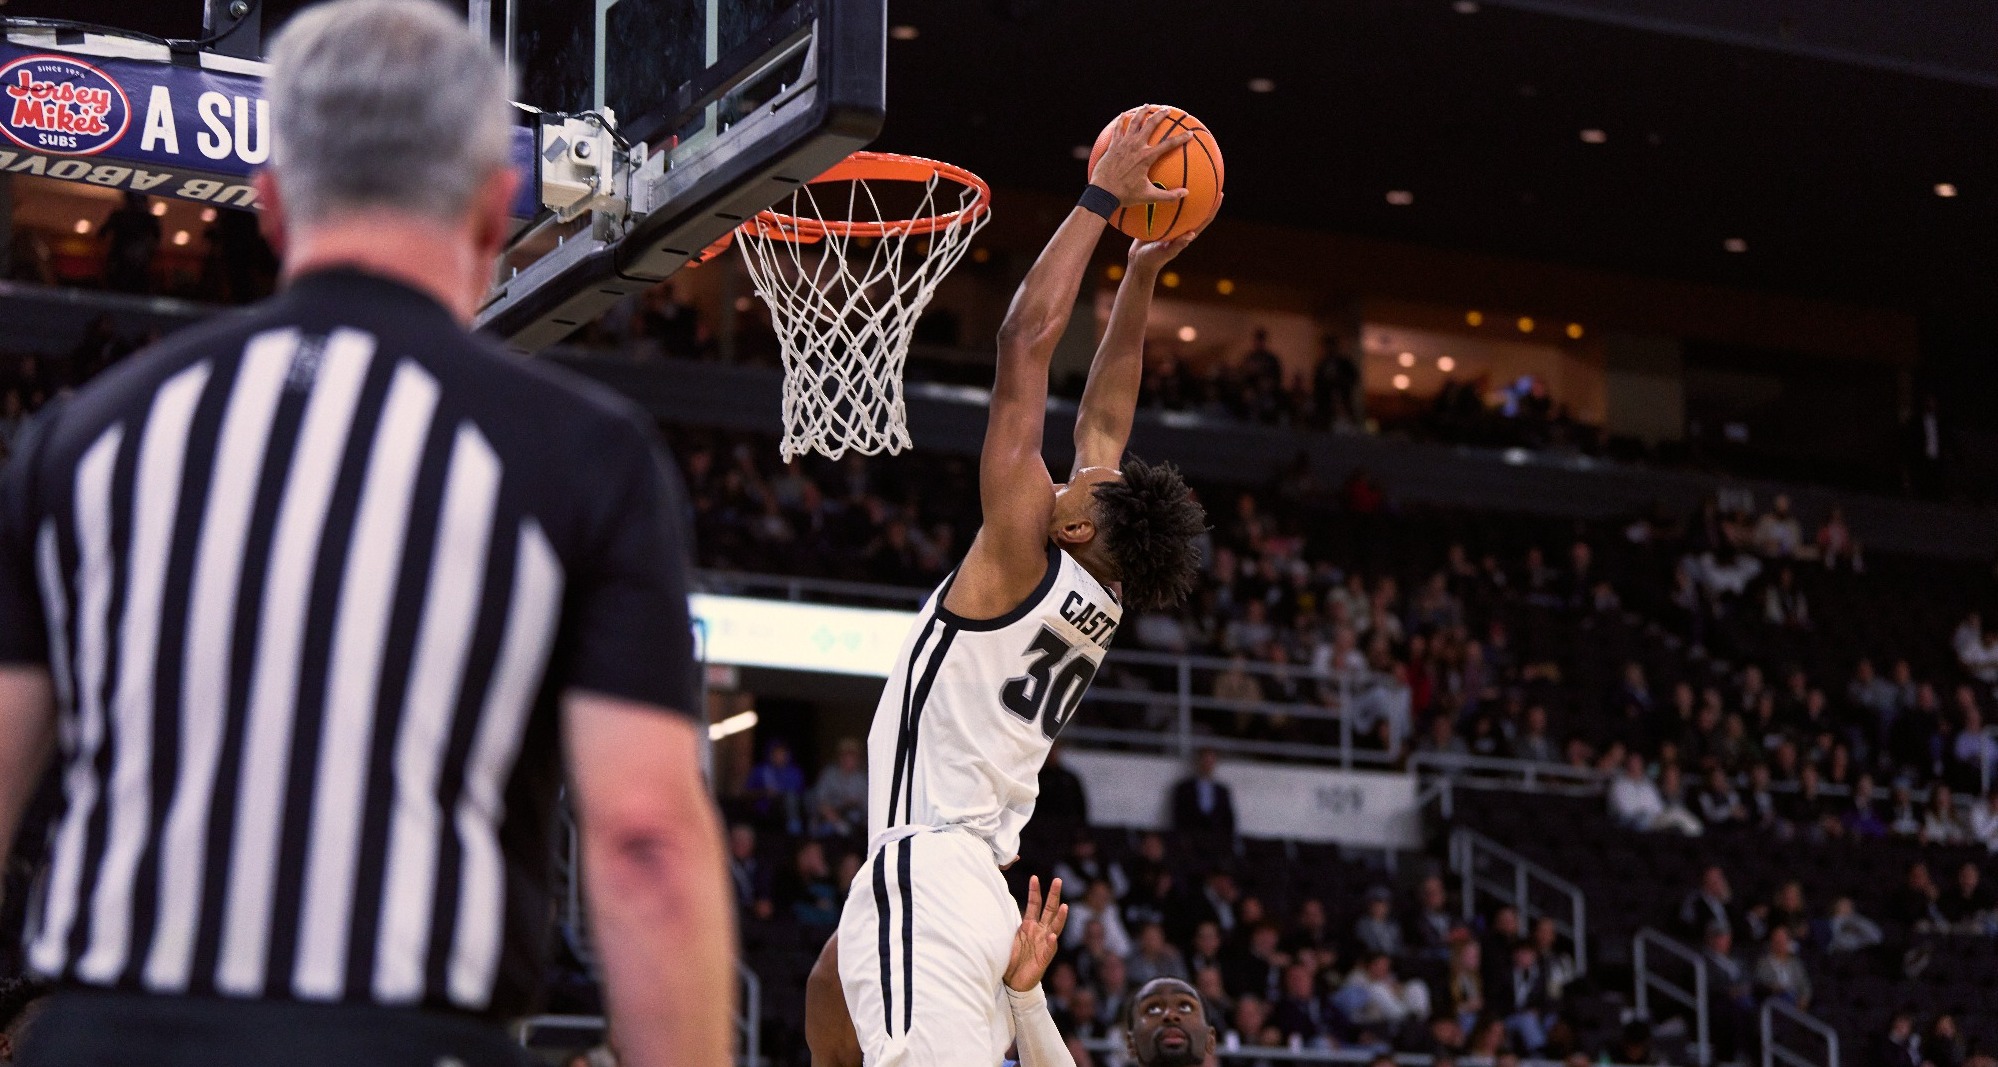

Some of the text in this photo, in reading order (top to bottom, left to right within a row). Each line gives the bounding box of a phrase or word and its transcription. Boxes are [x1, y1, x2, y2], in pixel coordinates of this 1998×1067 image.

[6, 69, 112, 115] Jersey
[11, 98, 110, 136] Mike's
[140, 84, 271, 165] A SU
[38, 132, 77, 148] SUBS
[175, 178, 266, 210] UB
[999, 622, 1099, 742] 30
